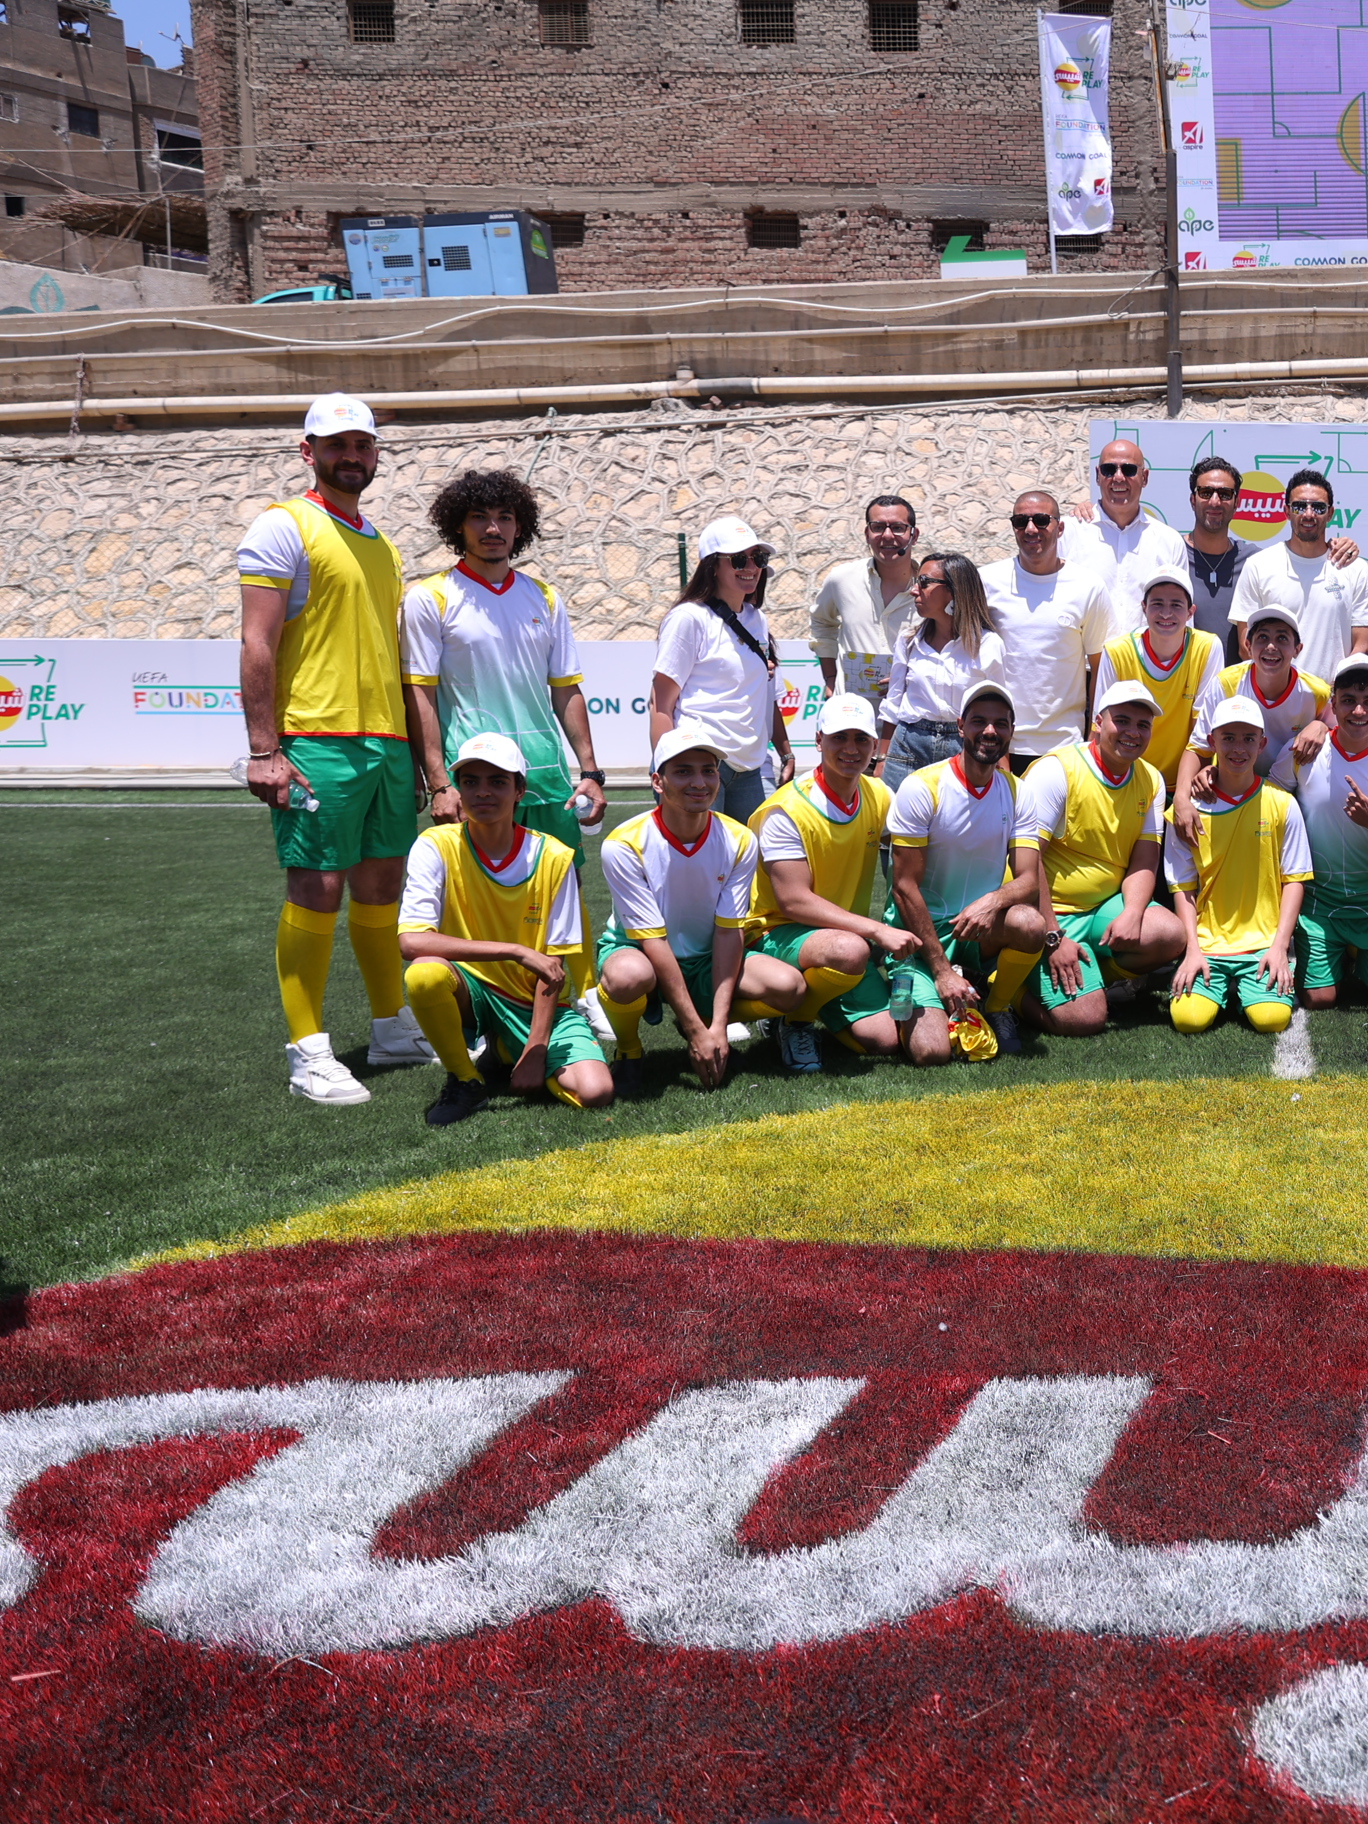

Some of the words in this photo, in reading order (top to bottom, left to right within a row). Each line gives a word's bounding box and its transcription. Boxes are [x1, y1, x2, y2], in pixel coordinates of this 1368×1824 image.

[1083, 70, 1094, 80] RE
[1081, 79, 1103, 89] PLAY
[1055, 120, 1106, 132] FOUNDATION
[1055, 152, 1086, 160] COMMON
[1058, 189, 1082, 201] ape
[1177, 219, 1215, 237] ape
[1258, 254, 1271, 263] RE
[1294, 256, 1346, 266] COMMON
[1326, 508, 1362, 529] AY
[132, 671, 168, 683] UEFA
[30, 684, 57, 702] RE
[27, 703, 85, 721] PLAY
